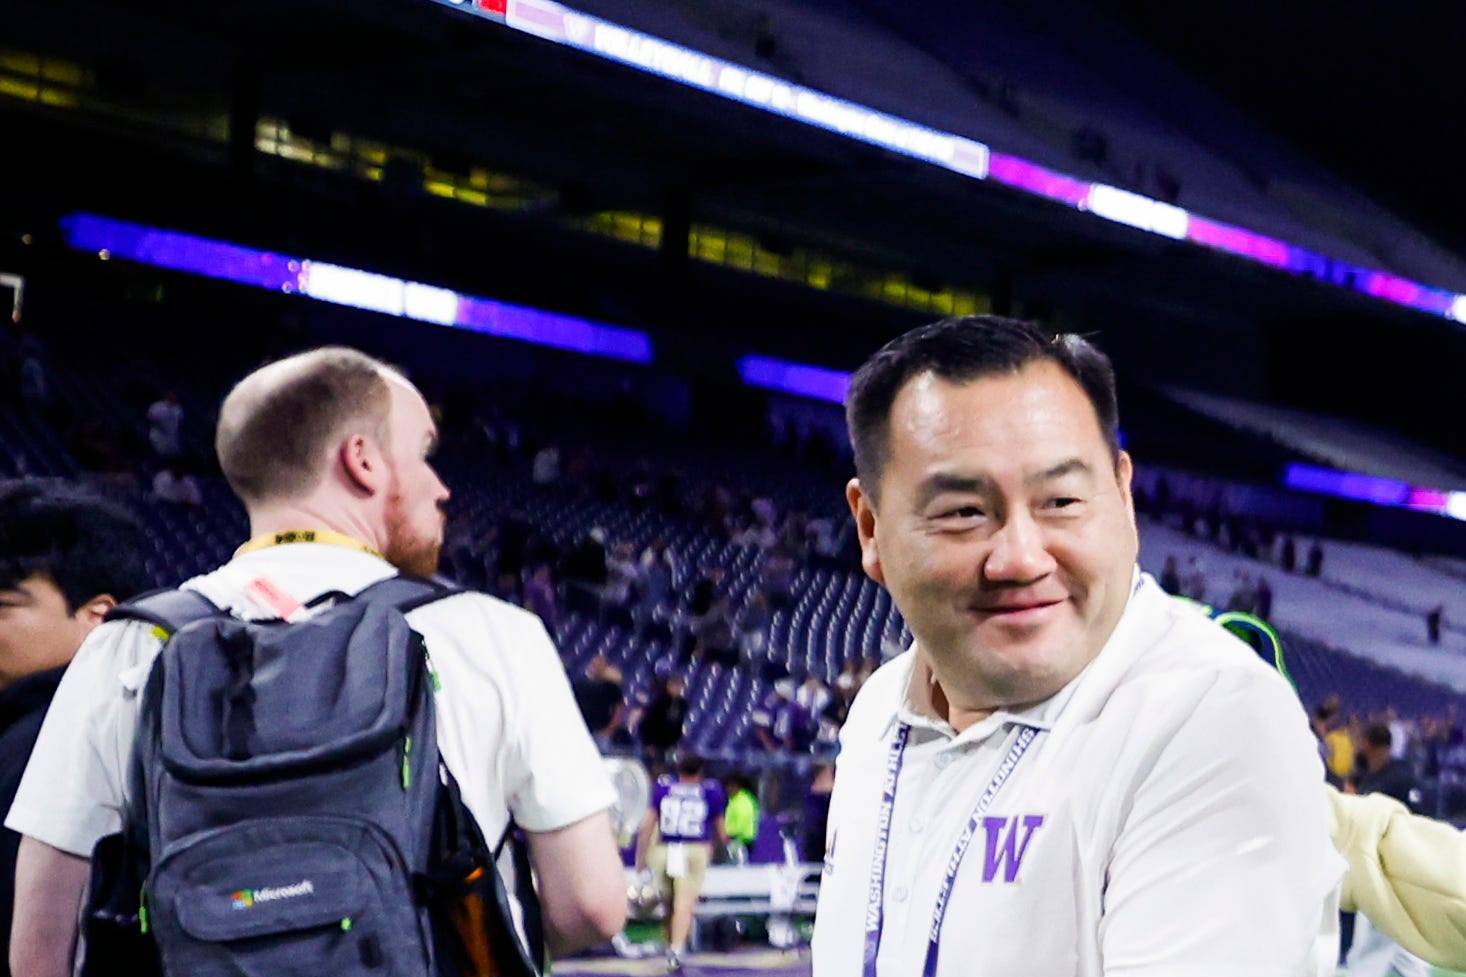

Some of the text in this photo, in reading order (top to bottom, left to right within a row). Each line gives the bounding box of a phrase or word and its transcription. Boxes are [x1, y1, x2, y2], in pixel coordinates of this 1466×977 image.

[866, 801, 891, 930] WASHINGTON
[981, 814, 1046, 884] W
[253, 879, 314, 903] Microsoft
